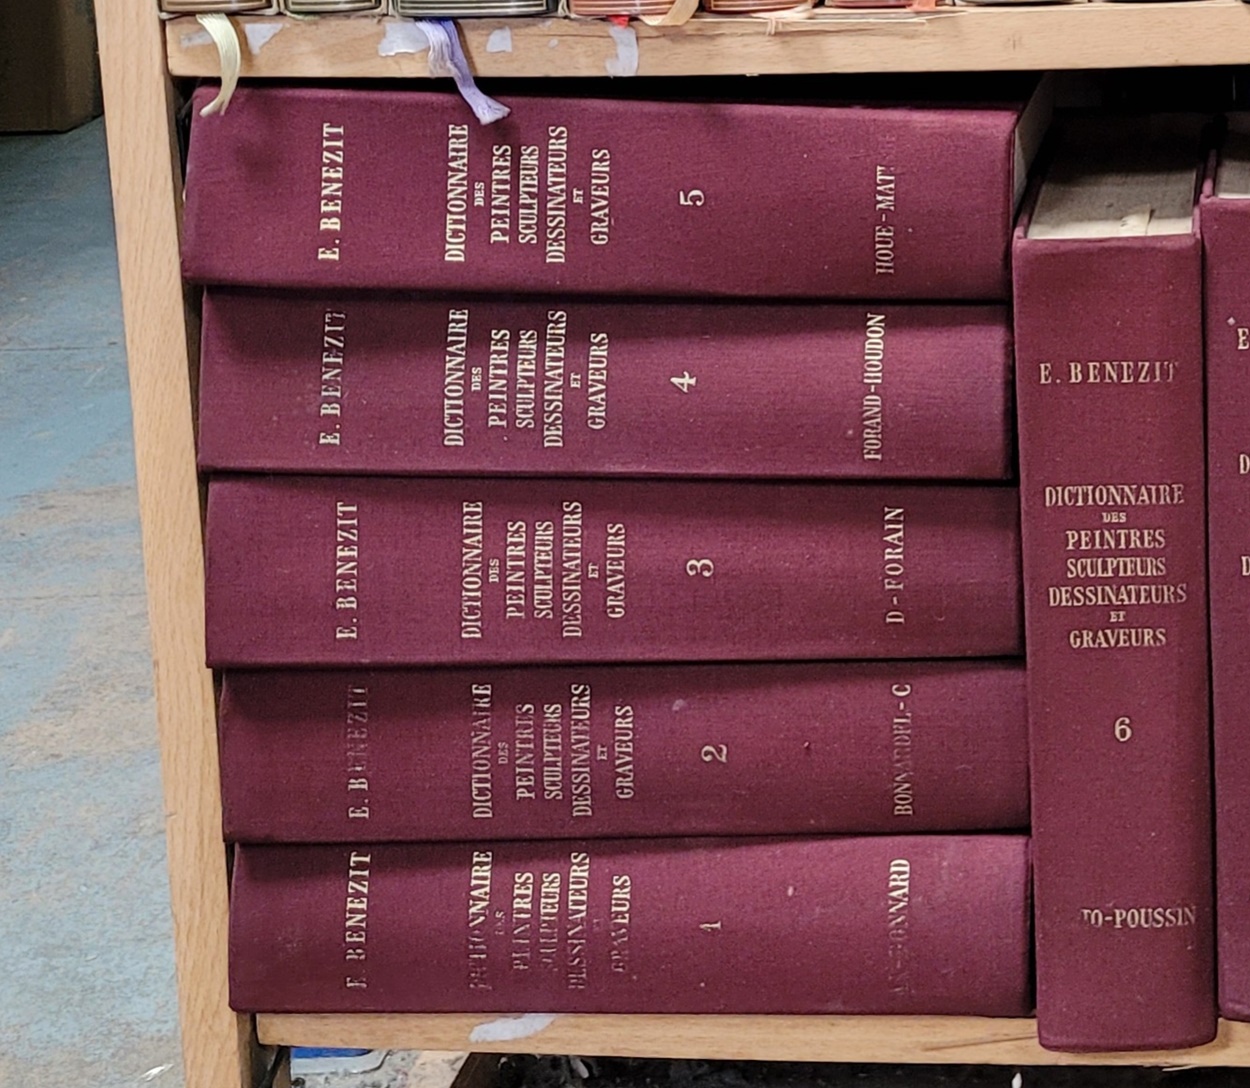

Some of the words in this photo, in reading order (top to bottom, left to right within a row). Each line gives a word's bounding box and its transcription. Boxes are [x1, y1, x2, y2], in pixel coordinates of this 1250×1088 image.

[319, 123, 344, 232] BENEZIT
[444, 124, 468, 262] DICTIONNAIRE
[474, 181, 485, 206] DES
[490, 144, 511, 244] PEINTRES
[518, 145, 539, 244] SCULPTEURS
[546, 125, 568, 263] DESSINATEURS
[573, 188, 583, 204] ET
[590, 148, 611, 245] GRAVEURS
[679, 189, 705, 207] 5
[443, 309, 469, 447] DICTIONNAIRE
[471, 366, 482, 392] DES
[488, 329, 511, 428] PEINTRES
[515, 330, 538, 429] SCULPTEURS
[543, 310, 568, 448] DESSINATEURS
[570, 372, 581, 389] ET
[588, 332, 609, 430] GRAVEURS
[669, 371, 697, 394] 4
[1069, 361, 1178, 384] BENEZIT
[1045, 483, 1185, 508] DICTIONNAIRE
[1065, 528, 1166, 551] PEINTRES
[1102, 512, 1127, 523] DES
[336, 501, 358, 610] BENEZIT
[461, 501, 483, 638] DICTIONNAIRE
[489, 558, 499, 583] DES
[506, 520, 527, 619] PEINTRES
[534, 520, 554, 619] SCULPTEURS
[562, 500, 583, 638] DESSINATEURS
[588, 562, 600, 579] ET
[606, 522, 626, 619] GRAVEURS
[686, 558, 715, 578] 3
[1048, 583, 1188, 607] DESSINATEURS
[1066, 556, 1166, 579] SCULPTEURS
[1069, 628, 1167, 649] GRAVEURS
[1109, 611, 1127, 623] ET
[471, 683, 493, 819] DICTIONNAIRE
[498, 741, 509, 765] DES
[515, 703, 536, 801] PEINTRES
[543, 703, 563, 801] SCULPTEURS
[571, 683, 592, 818] DESSINATEURS
[597, 743, 607, 761] ET
[615, 704, 635, 800] GRAVEURS
[701, 744, 728, 764] 2
[1114, 716, 1133, 742] 6
[345, 851, 371, 961] BENEZIT
[699, 920, 722, 932] 1
